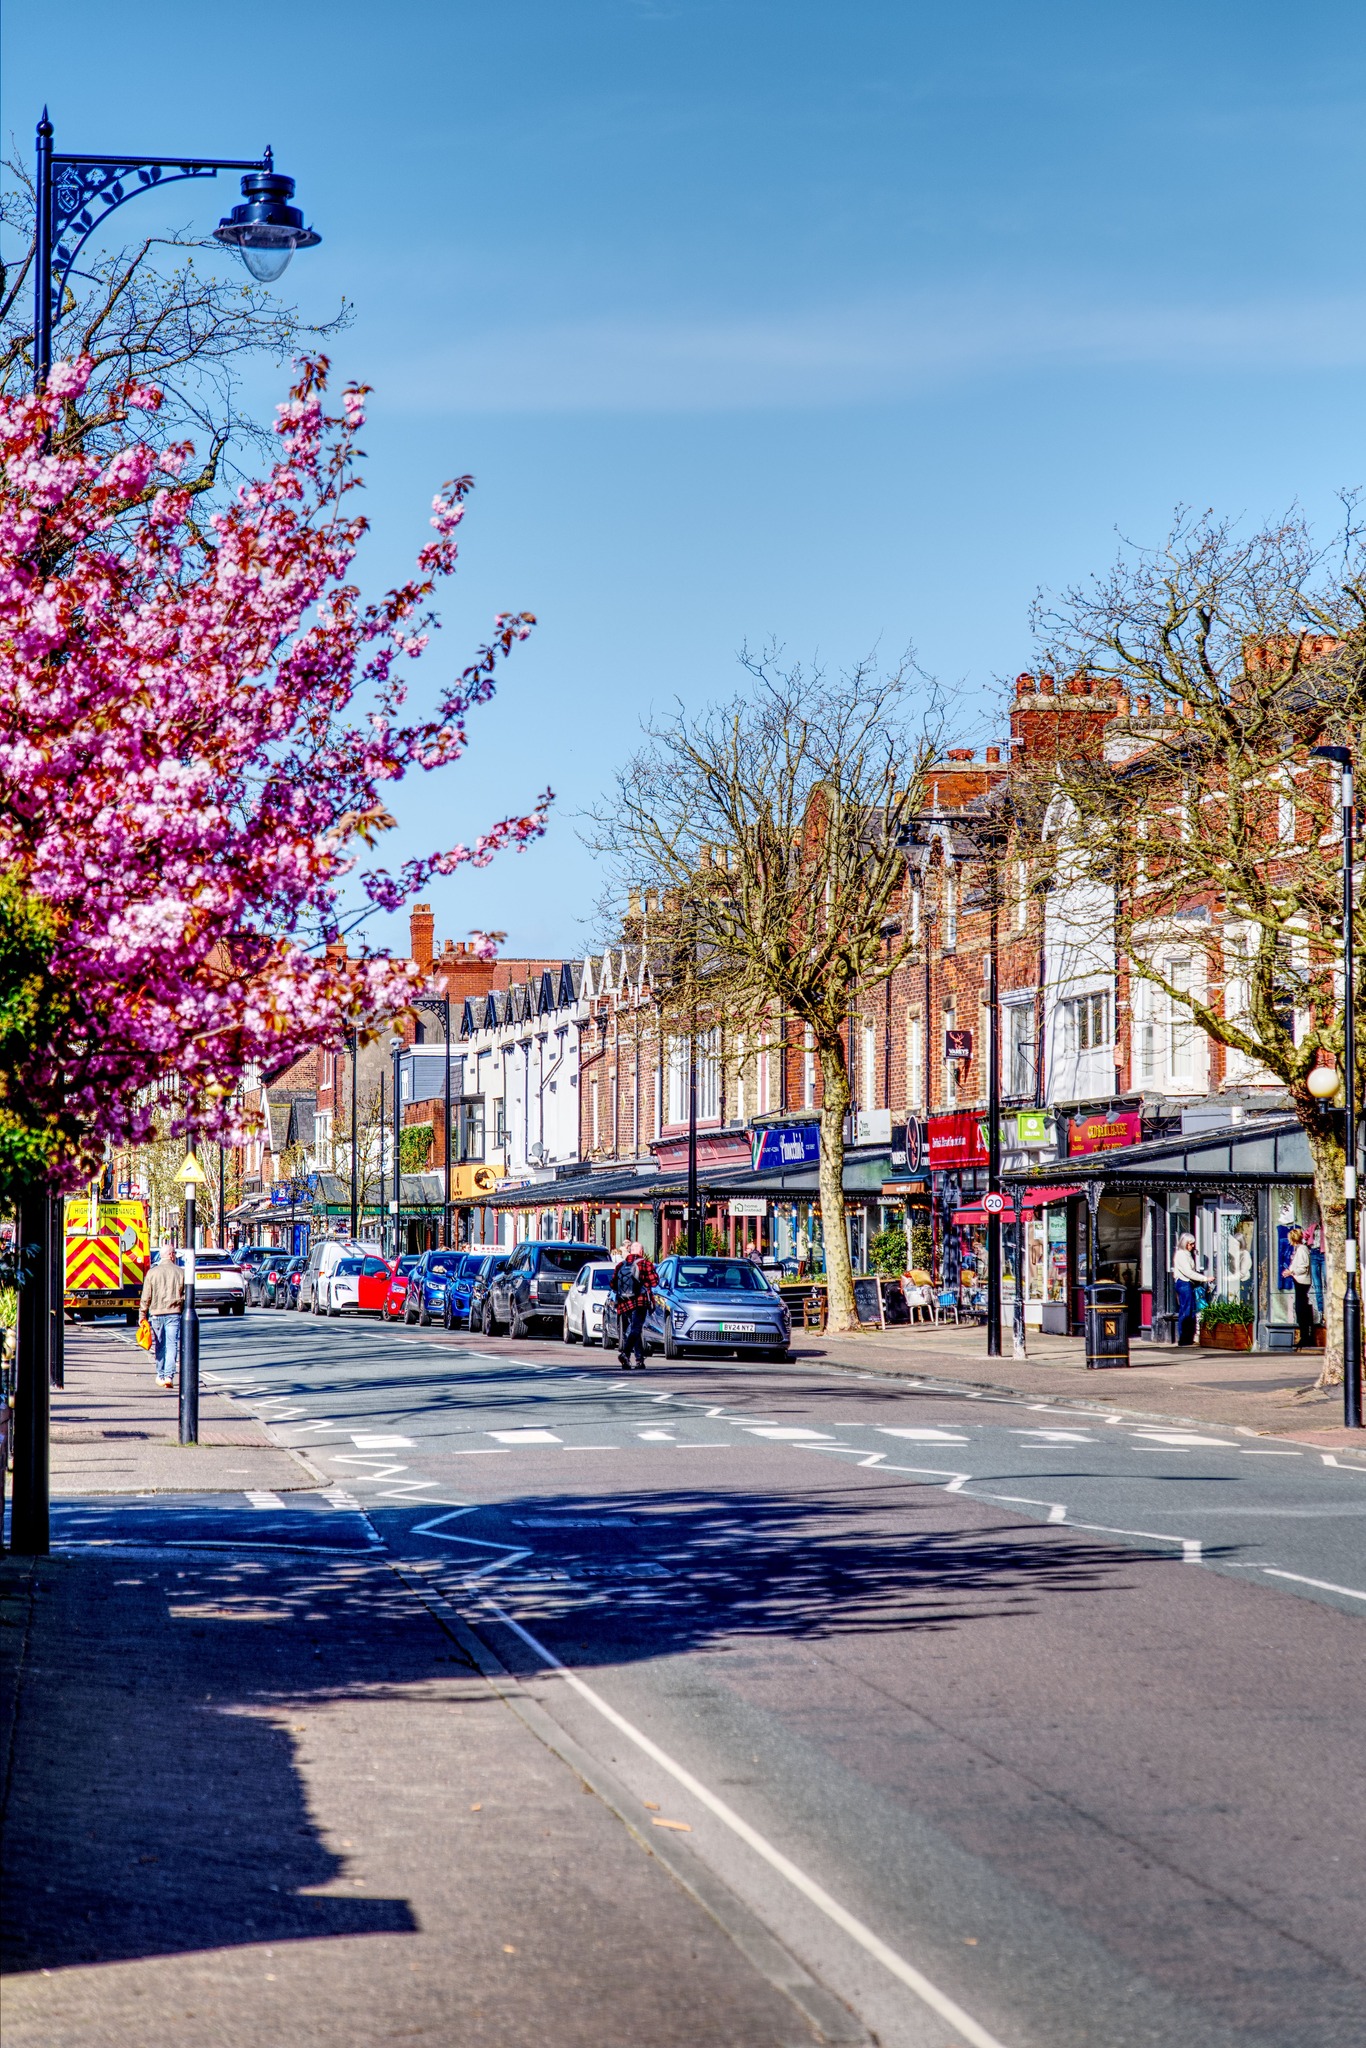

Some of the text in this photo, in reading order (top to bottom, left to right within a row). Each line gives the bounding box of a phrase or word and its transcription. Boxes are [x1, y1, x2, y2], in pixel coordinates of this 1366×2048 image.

[987, 1199, 1002, 1208] 20
[74, 1207, 136, 1215] HIGH MAINTENANCE
[399, 1206, 421, 1214] opping
[723, 1323, 754, 1332] BV24 NYZ
